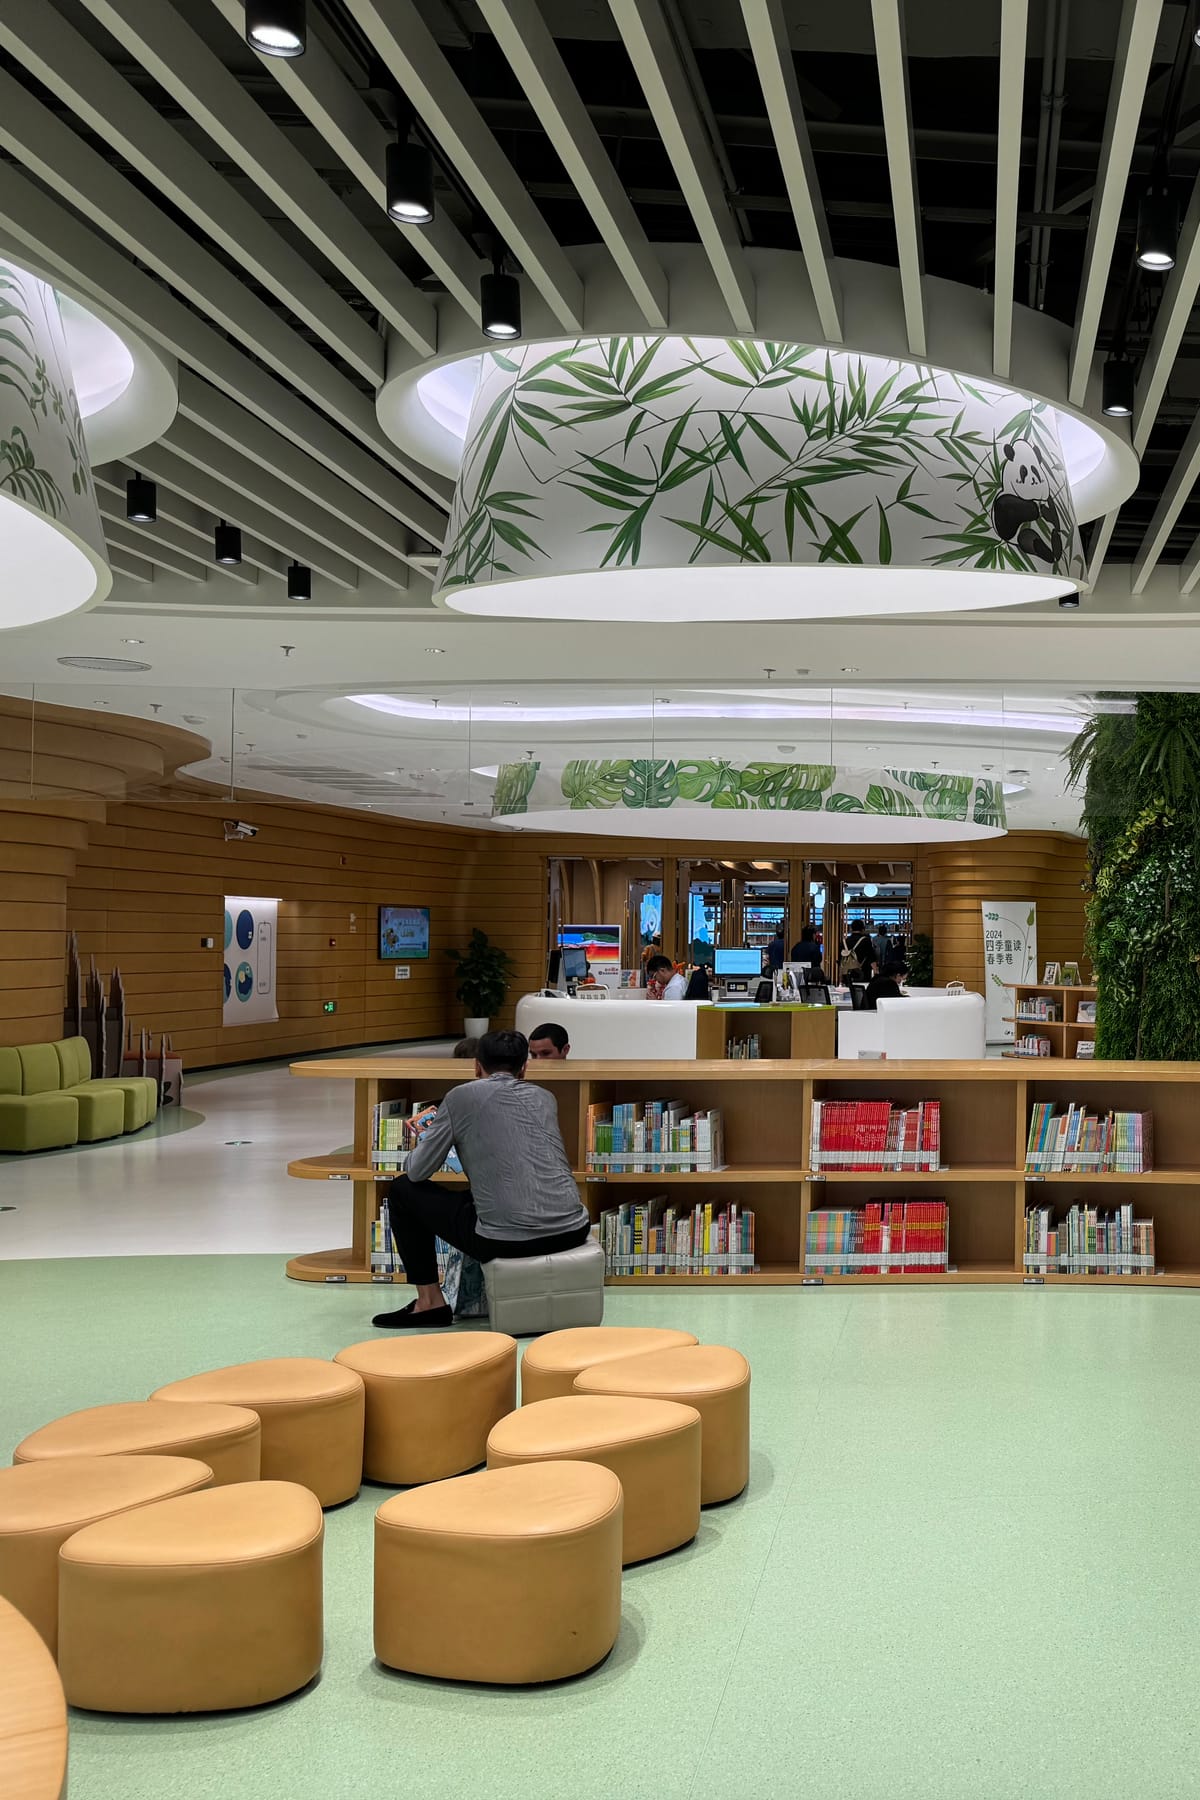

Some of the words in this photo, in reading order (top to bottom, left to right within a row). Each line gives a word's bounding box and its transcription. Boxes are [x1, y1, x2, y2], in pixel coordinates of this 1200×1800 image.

[985, 930, 1002, 939] 2024
[985, 940, 1021, 952] 四季童读
[987, 953, 1014, 965] 春季卷
